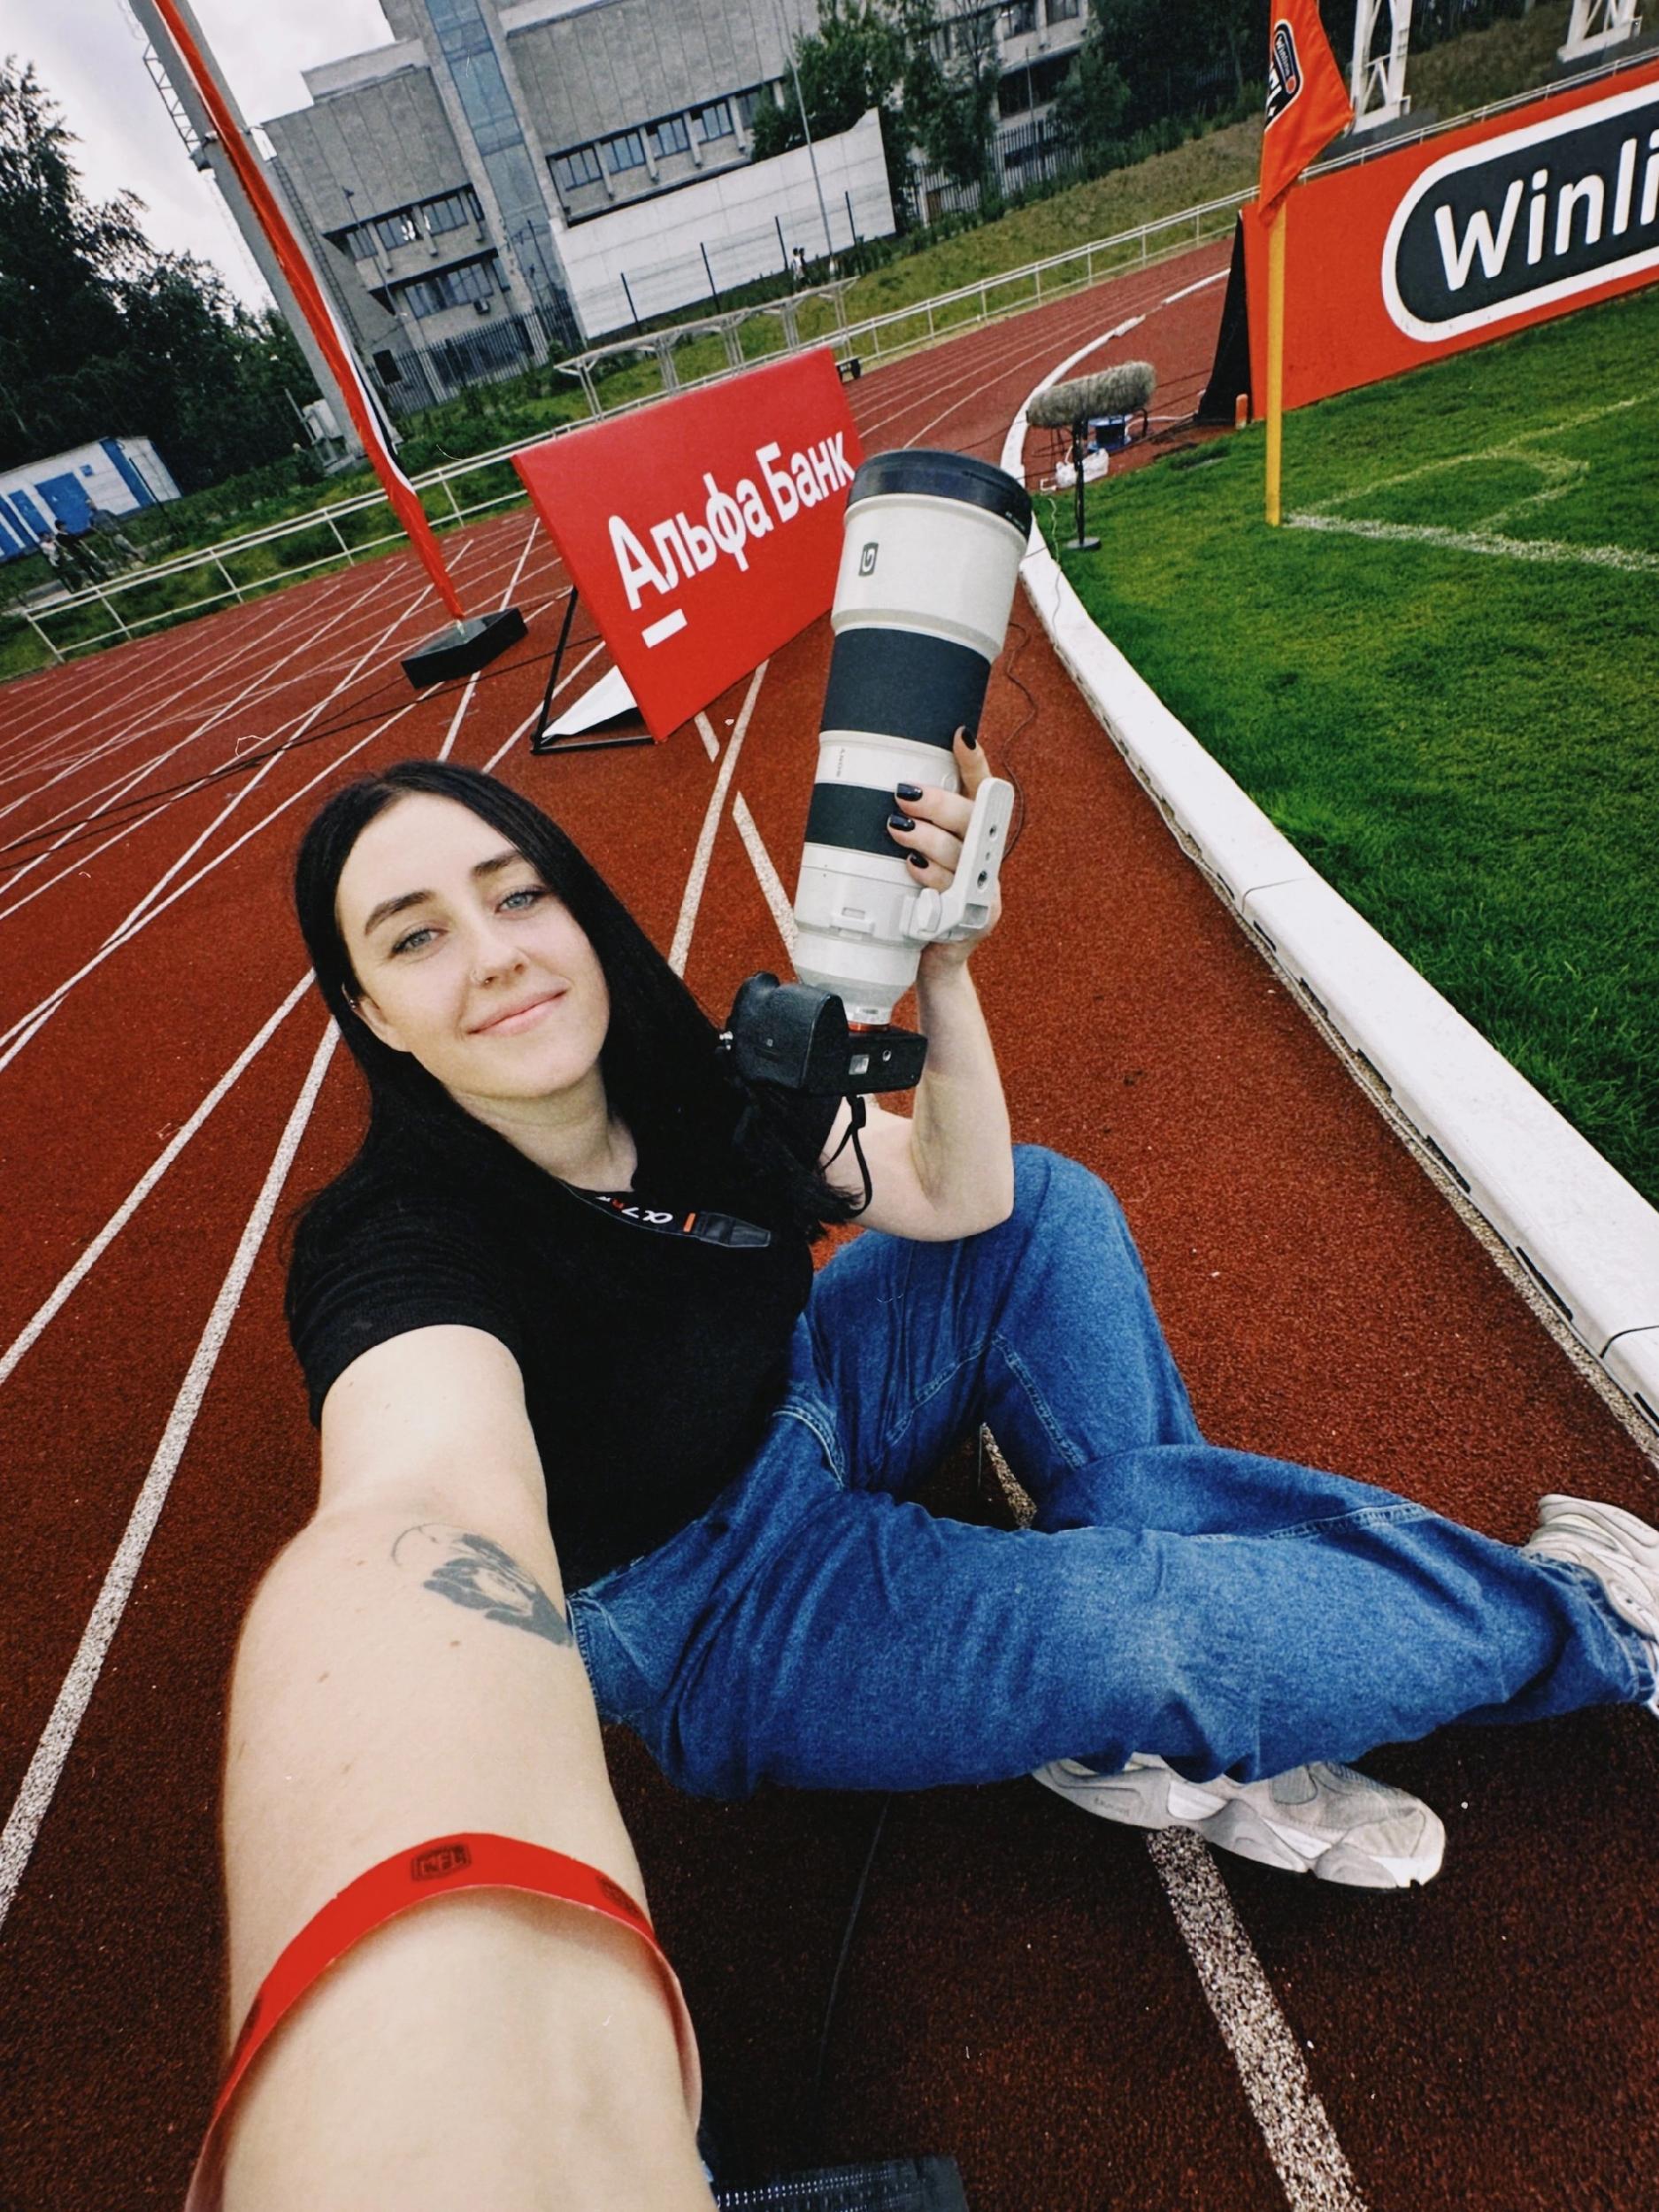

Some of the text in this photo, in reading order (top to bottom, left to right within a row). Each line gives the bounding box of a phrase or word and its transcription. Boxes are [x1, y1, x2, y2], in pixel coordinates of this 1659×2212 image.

[1275, 35, 1290, 77] Winline
[1433, 128, 1659, 292] Winli
[608, 430, 856, 611] Альфа Банк
